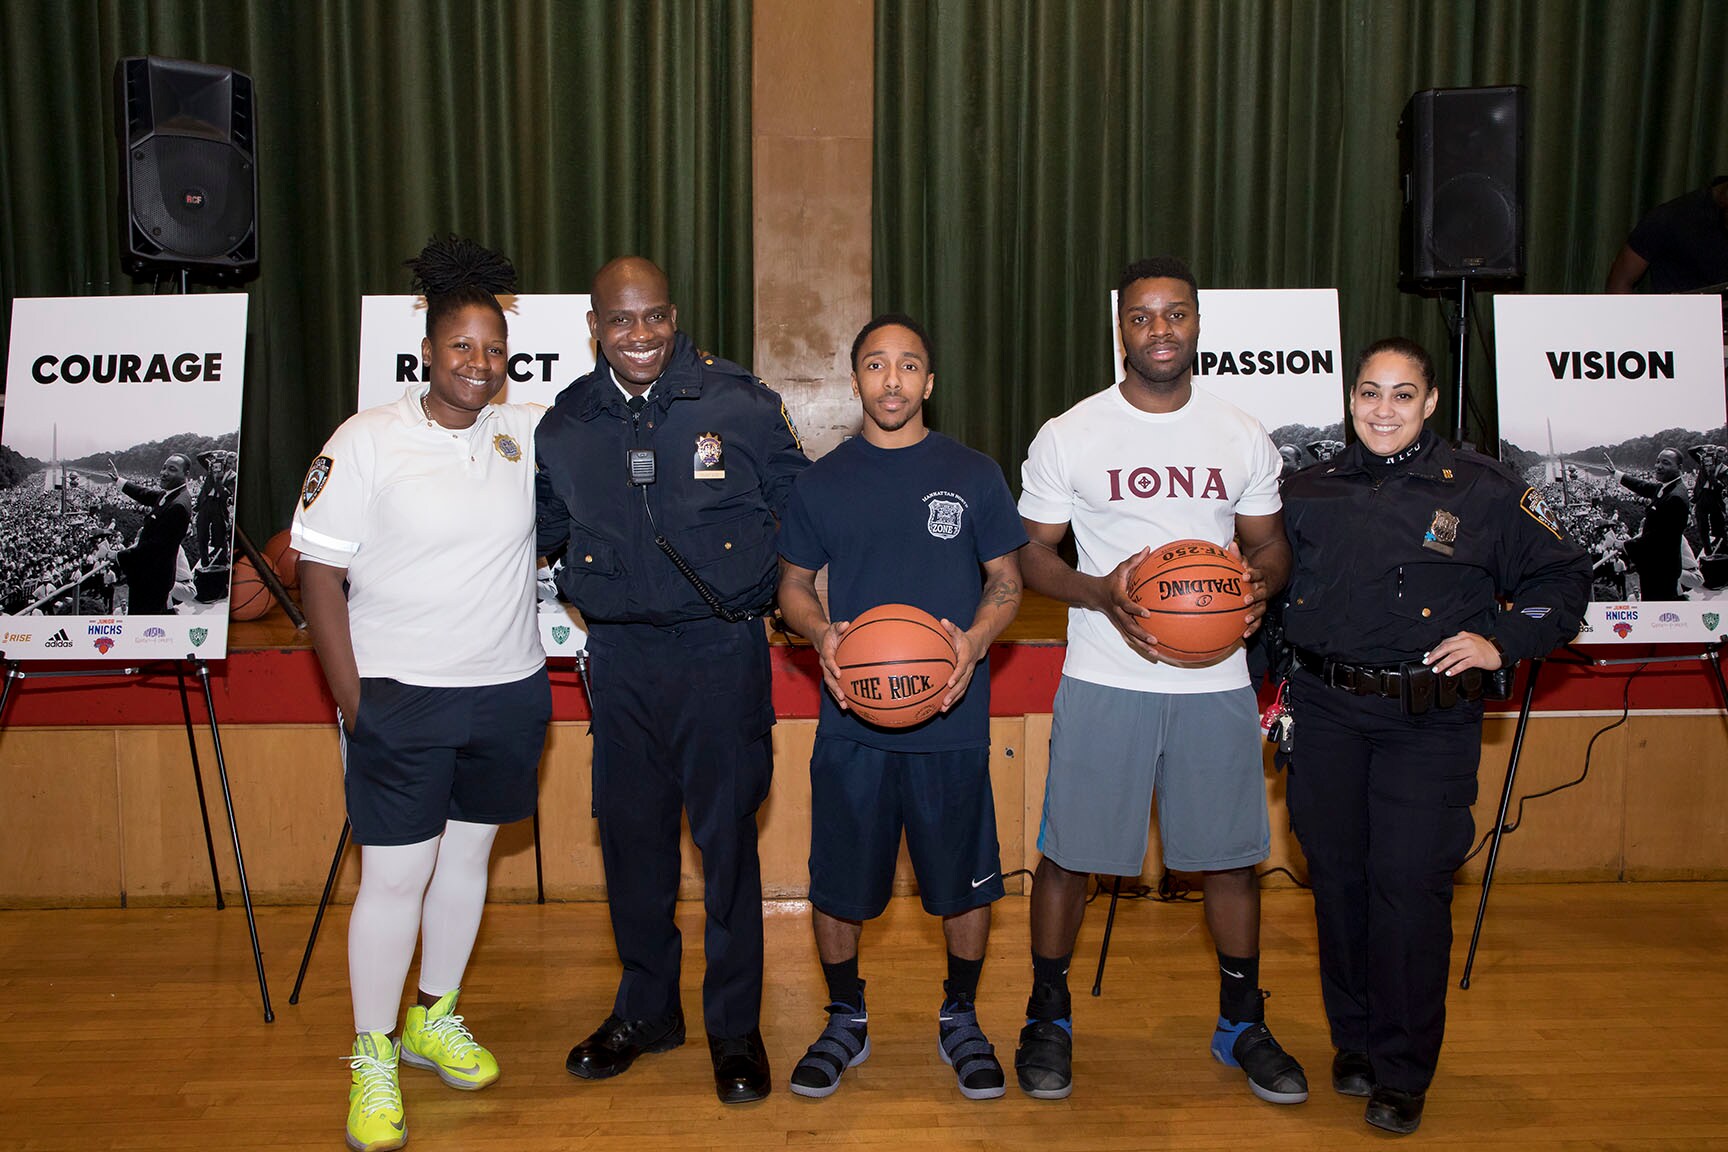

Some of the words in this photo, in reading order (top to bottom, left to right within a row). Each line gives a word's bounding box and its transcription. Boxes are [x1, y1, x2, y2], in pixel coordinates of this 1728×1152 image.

[186, 195, 201, 204] RCF
[31, 352, 222, 384] COURAGE
[1191, 350, 1333, 375] PASSION
[1545, 350, 1675, 380] VISION
[1107, 466, 1229, 501] IONA
[932, 523, 953, 534] ZONE
[1159, 578, 1241, 600] SPALDING
[1606, 611, 1638, 621] KNICKS
[88, 625, 122, 635] KNICKS
[1579, 625, 1594, 633] das
[9, 634, 32, 642] RISE
[44, 640, 73, 648] adidas
[851, 677, 882, 701] THE
[888, 675, 932, 700] ROCK
